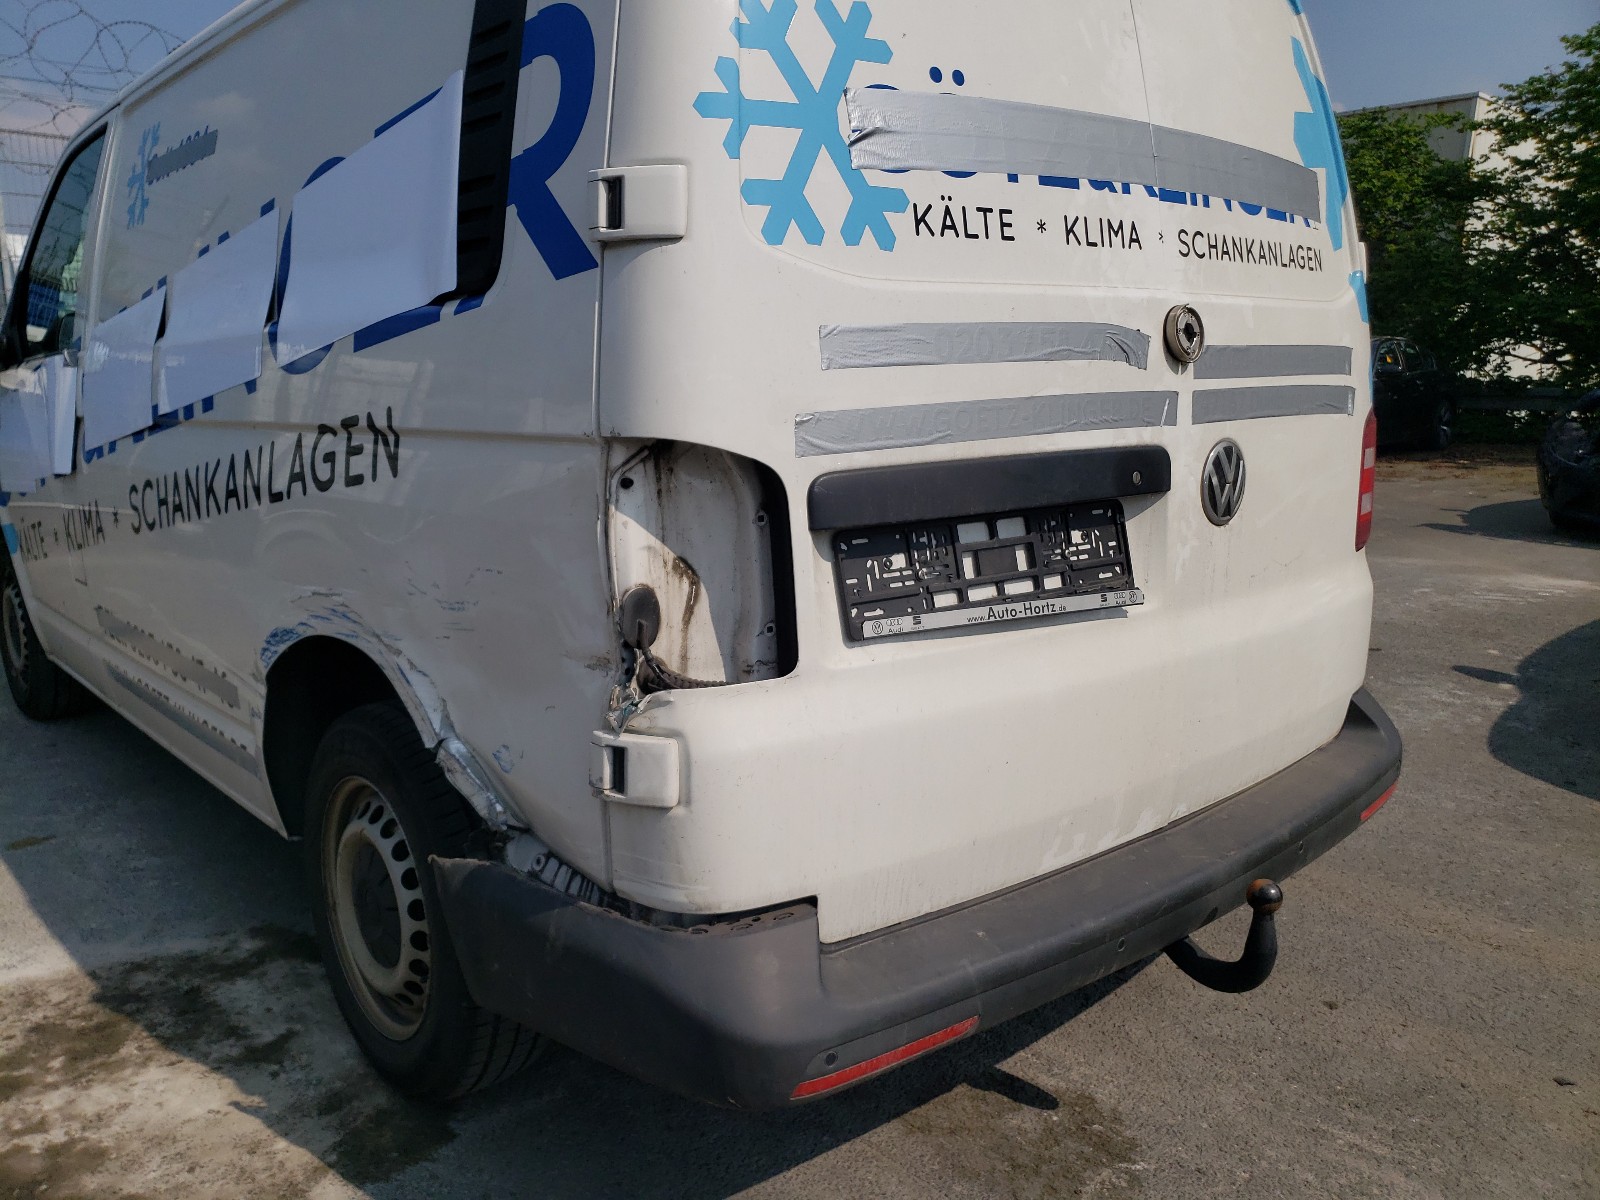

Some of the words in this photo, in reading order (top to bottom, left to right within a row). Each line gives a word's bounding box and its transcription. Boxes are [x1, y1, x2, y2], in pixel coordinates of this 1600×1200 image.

[912, 194, 1016, 242] KÄLTE
[1063, 214, 1143, 251] KLIMA
[1177, 228, 1323, 272] SCHANKANLAGEN
[62, 497, 106, 553] KLIMA
[128, 405, 400, 535] SCHANKANLAGEN
[966, 601, 1067, 623] www.Auto-Hortz.de
